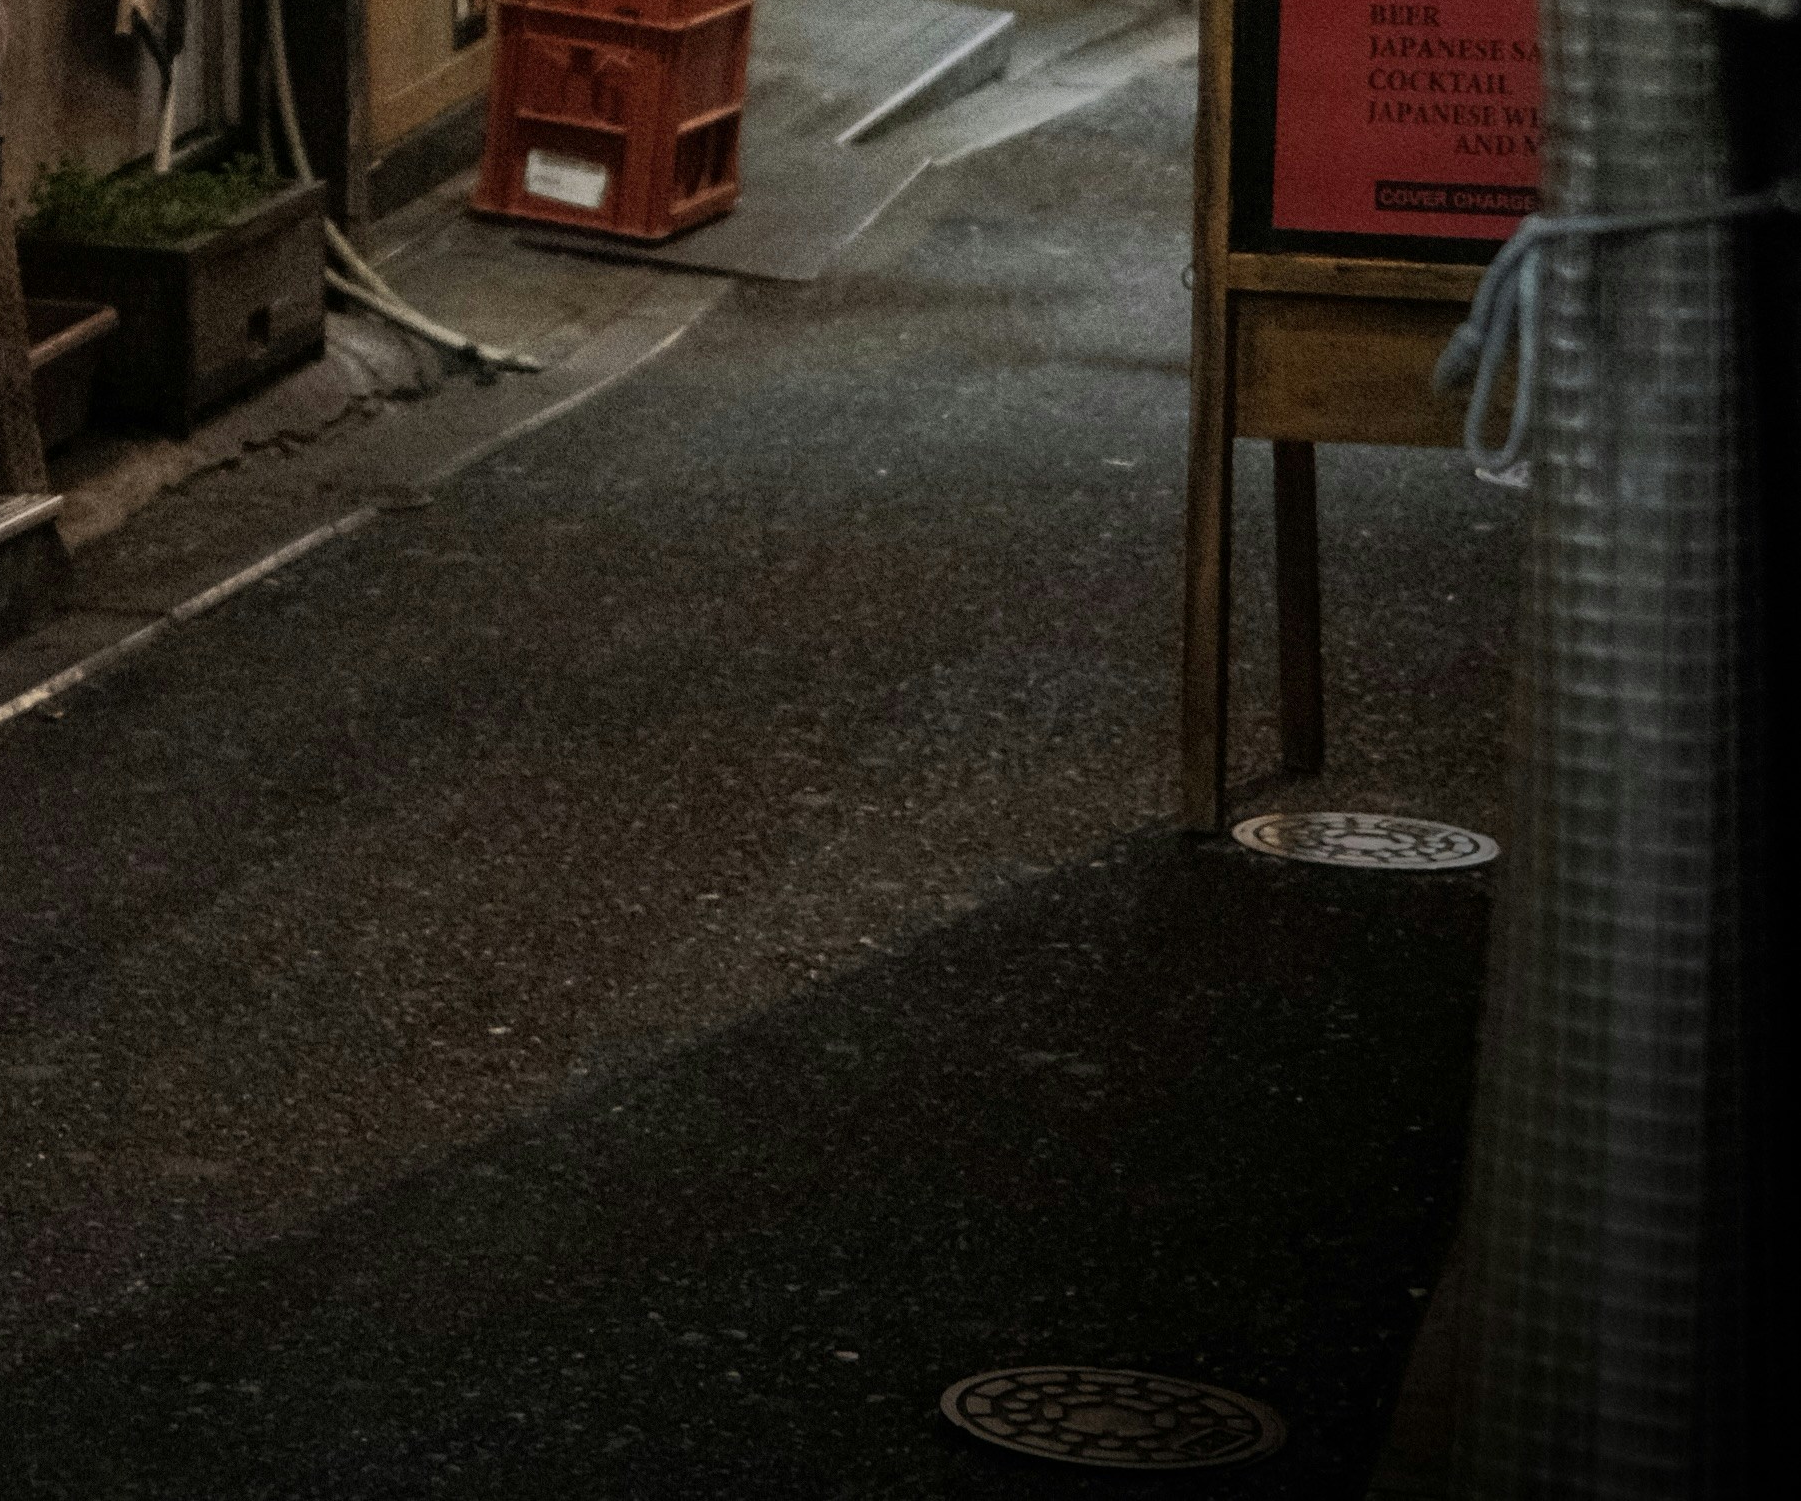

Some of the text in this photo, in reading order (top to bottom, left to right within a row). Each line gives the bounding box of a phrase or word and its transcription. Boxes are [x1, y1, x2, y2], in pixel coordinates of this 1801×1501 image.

[1369, 3, 1441, 28] BEER
[1368, 35, 1504, 62] JAPANESE
[1367, 68, 1514, 95] COCKTAIL
[1366, 100, 1497, 128] JAPANESE
[1453, 134, 1517, 157] AND
